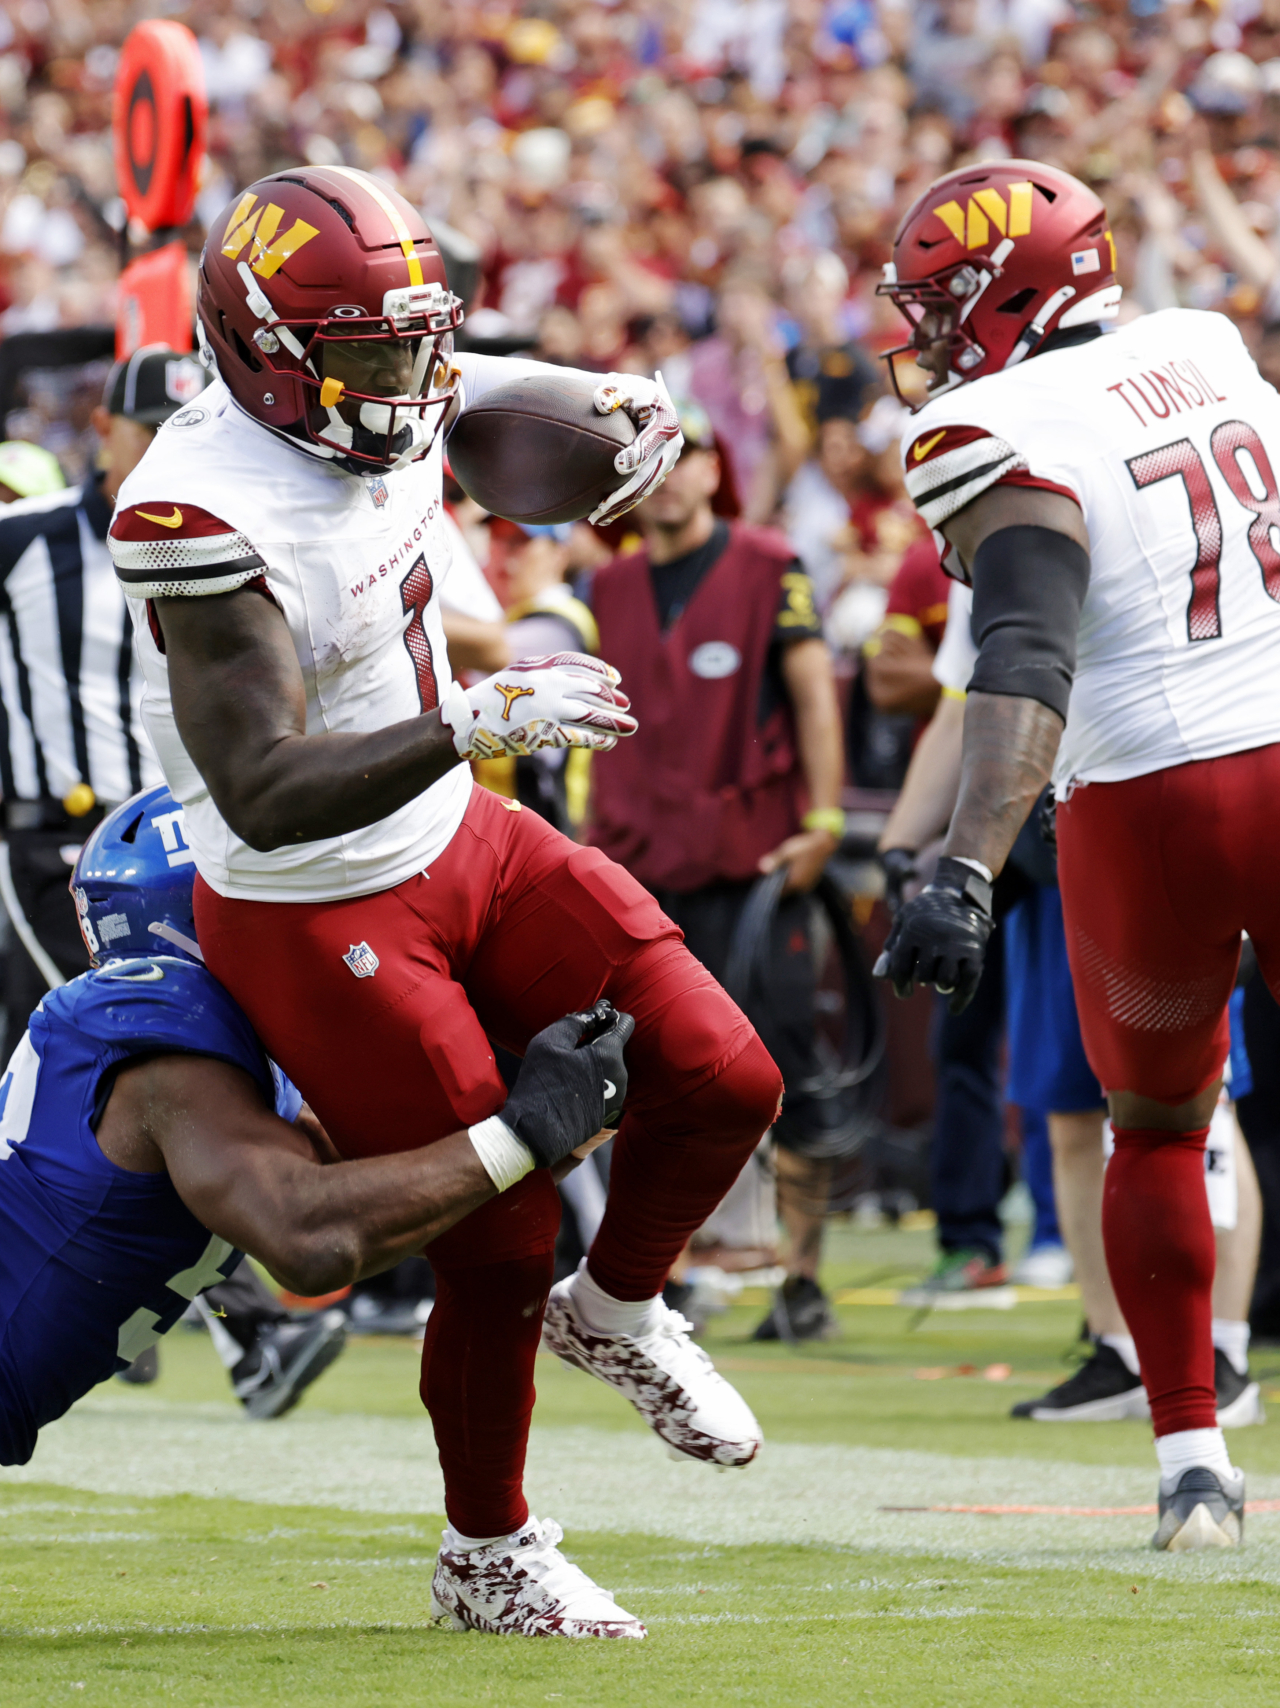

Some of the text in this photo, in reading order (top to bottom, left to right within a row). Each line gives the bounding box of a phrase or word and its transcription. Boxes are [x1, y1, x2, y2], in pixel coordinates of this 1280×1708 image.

[220, 192, 321, 280] W
[932, 181, 1033, 251] W
[1105, 358, 1228, 428] TUNSIL
[350, 496, 441, 598] WASHINGTON
[1124, 419, 1280, 643] 78
[399, 551, 440, 716] 1
[353, 955, 376, 974] NFL
